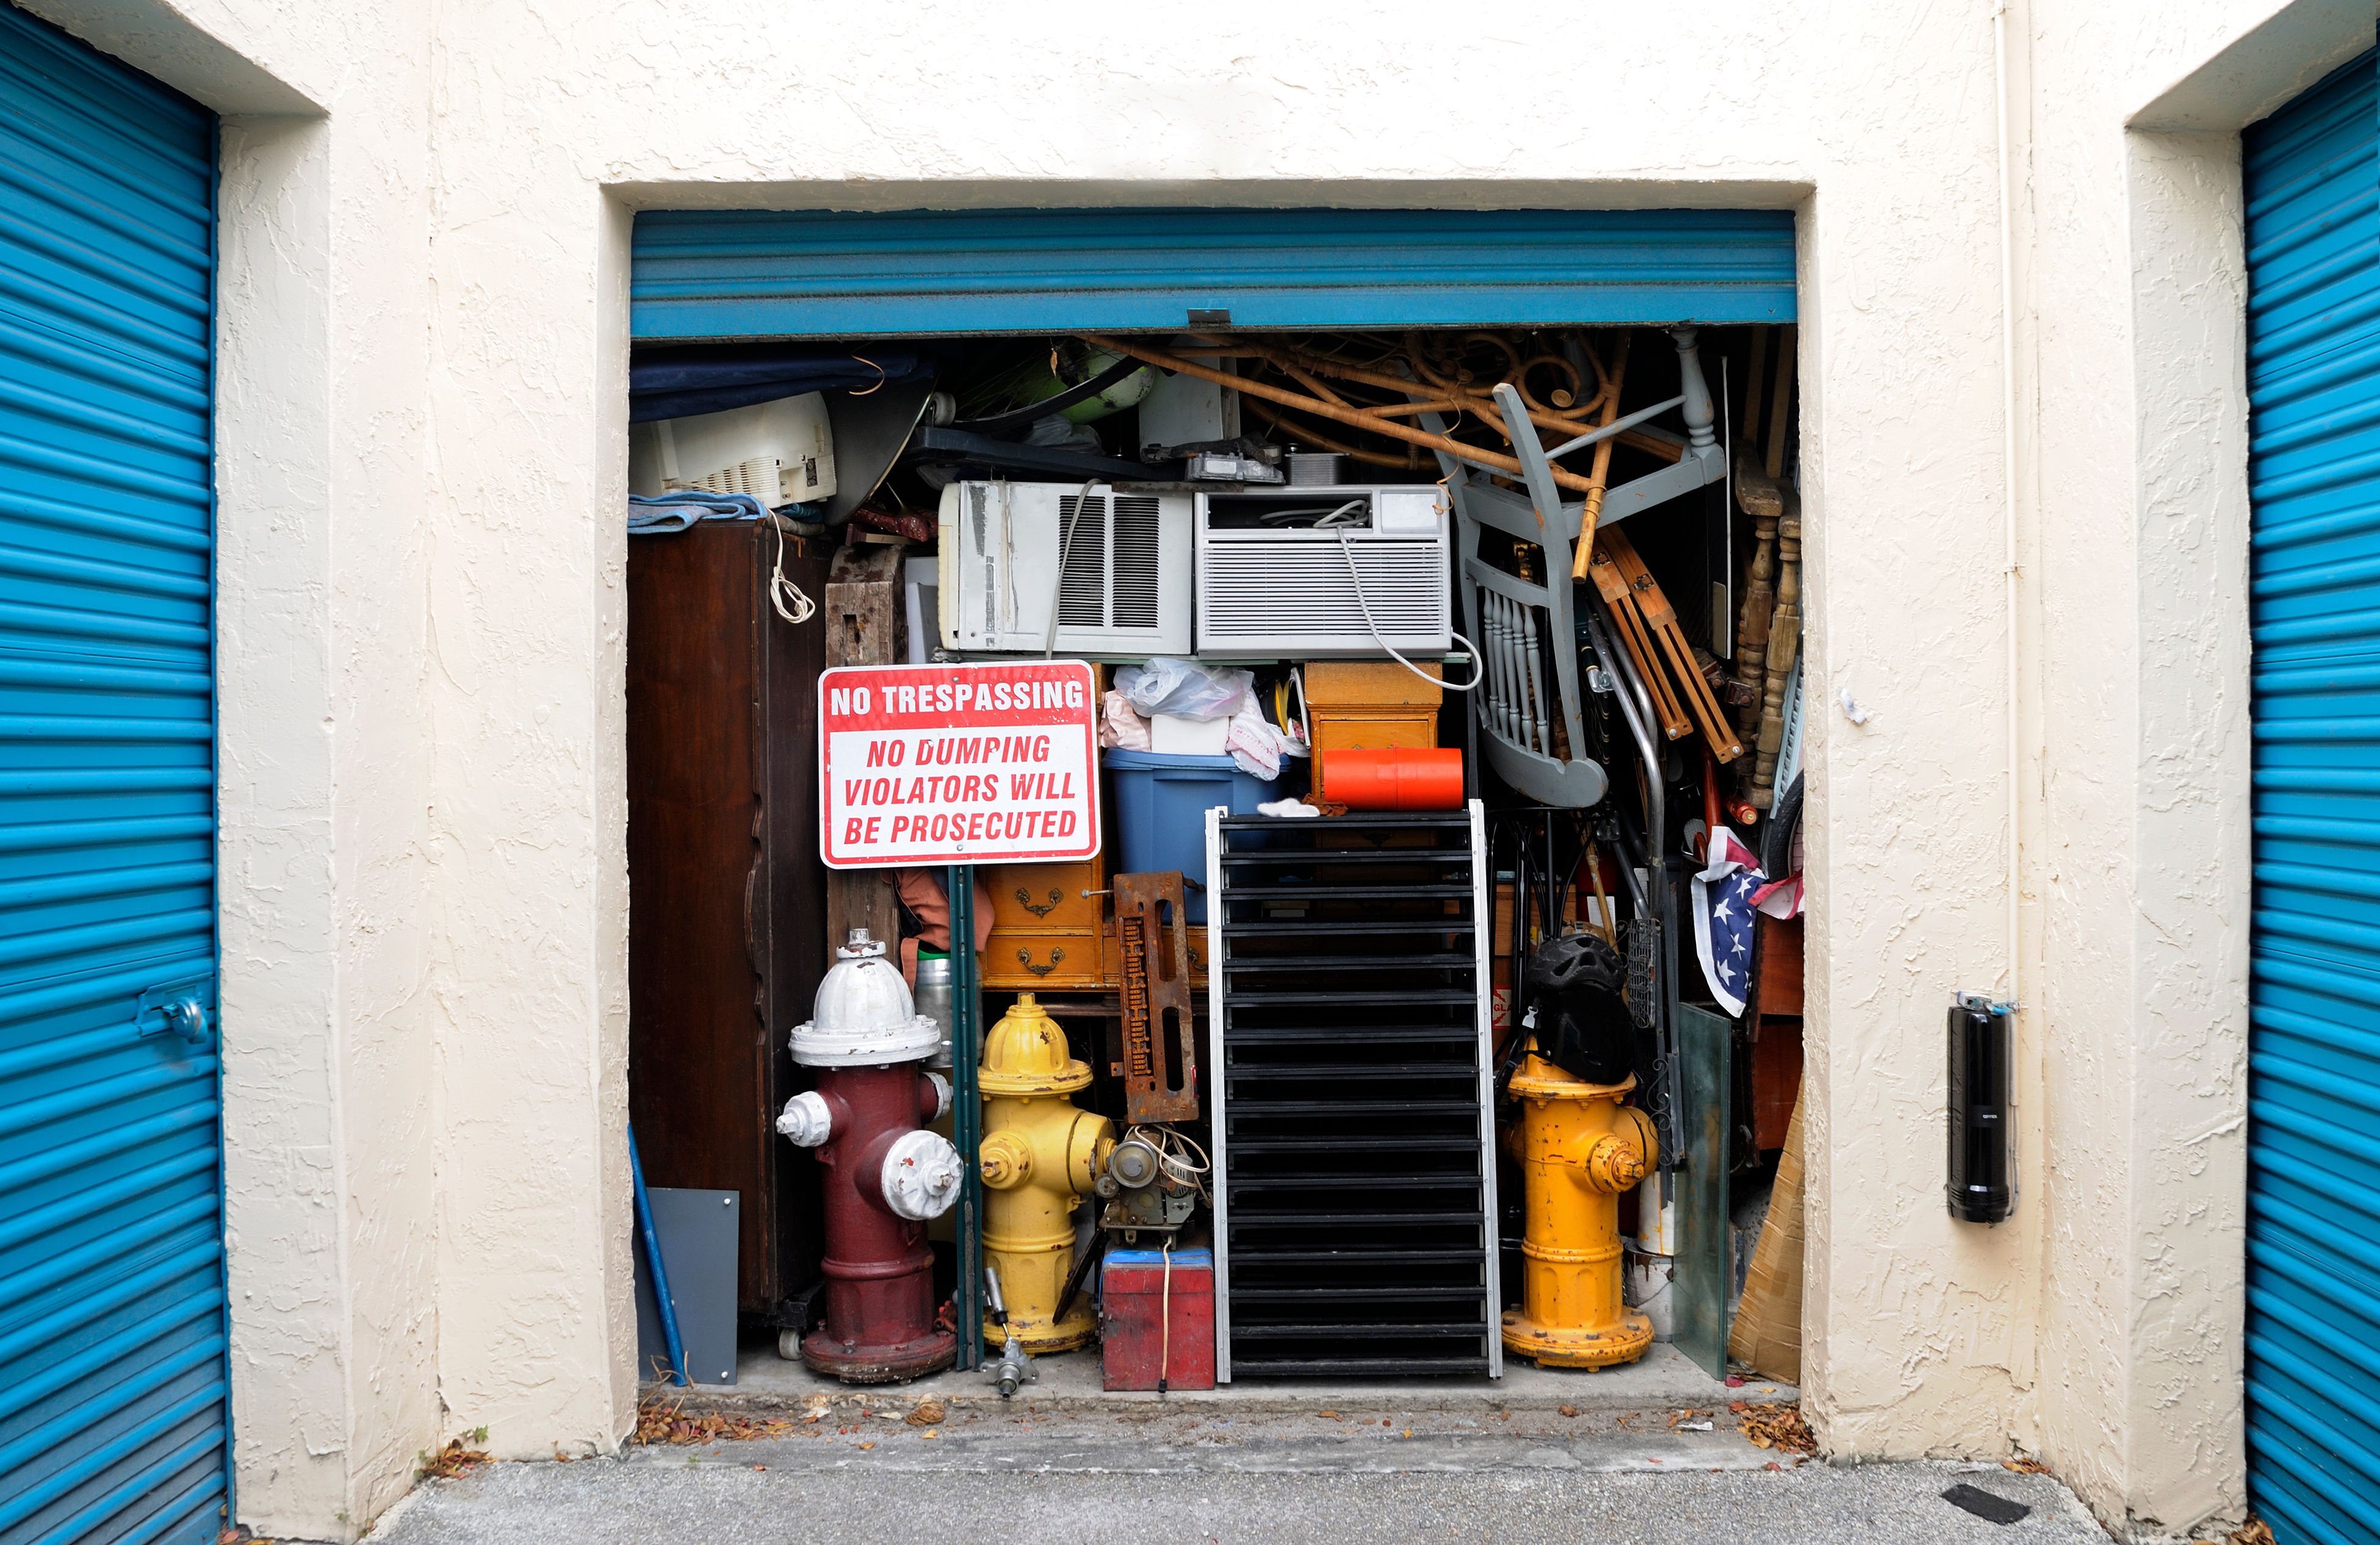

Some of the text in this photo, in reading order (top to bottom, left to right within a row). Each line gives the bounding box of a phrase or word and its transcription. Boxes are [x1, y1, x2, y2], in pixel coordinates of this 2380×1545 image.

[831, 680, 1084, 715] NO TRESPASSING
[867, 735, 1050, 767] NO DUMPING
[845, 772, 1075, 806] VIOLATORS WILL
[844, 810, 1076, 844] BE PROSECUTED
